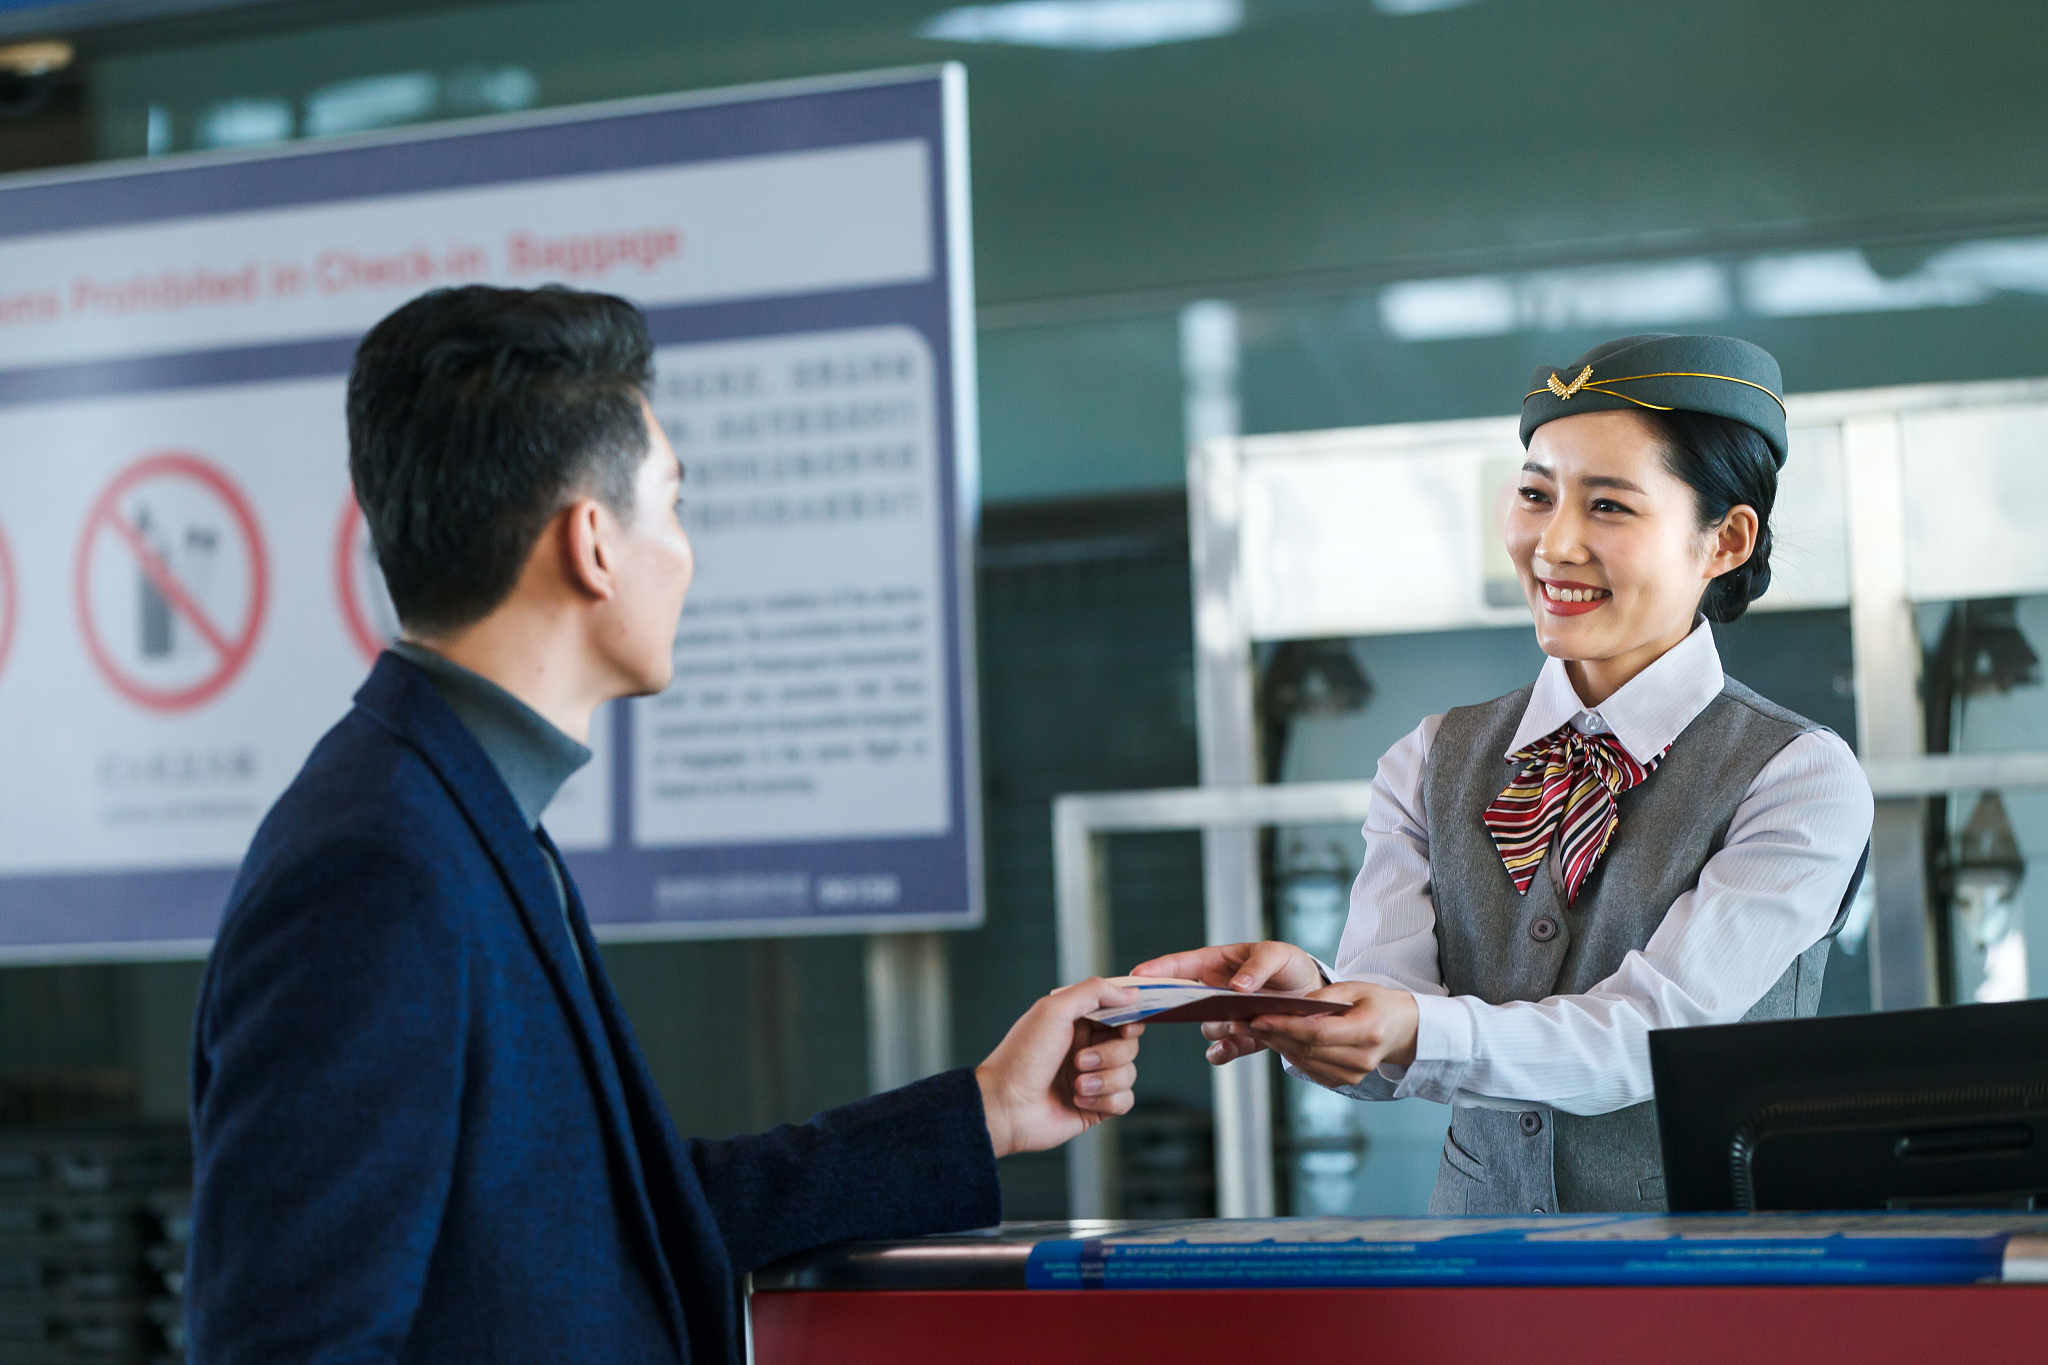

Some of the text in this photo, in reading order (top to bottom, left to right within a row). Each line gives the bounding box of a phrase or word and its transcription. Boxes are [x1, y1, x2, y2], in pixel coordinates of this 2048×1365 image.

[70, 263, 258, 316] Prohibited
[270, 257, 305, 298] in
[508, 228, 682, 280] Baggage
